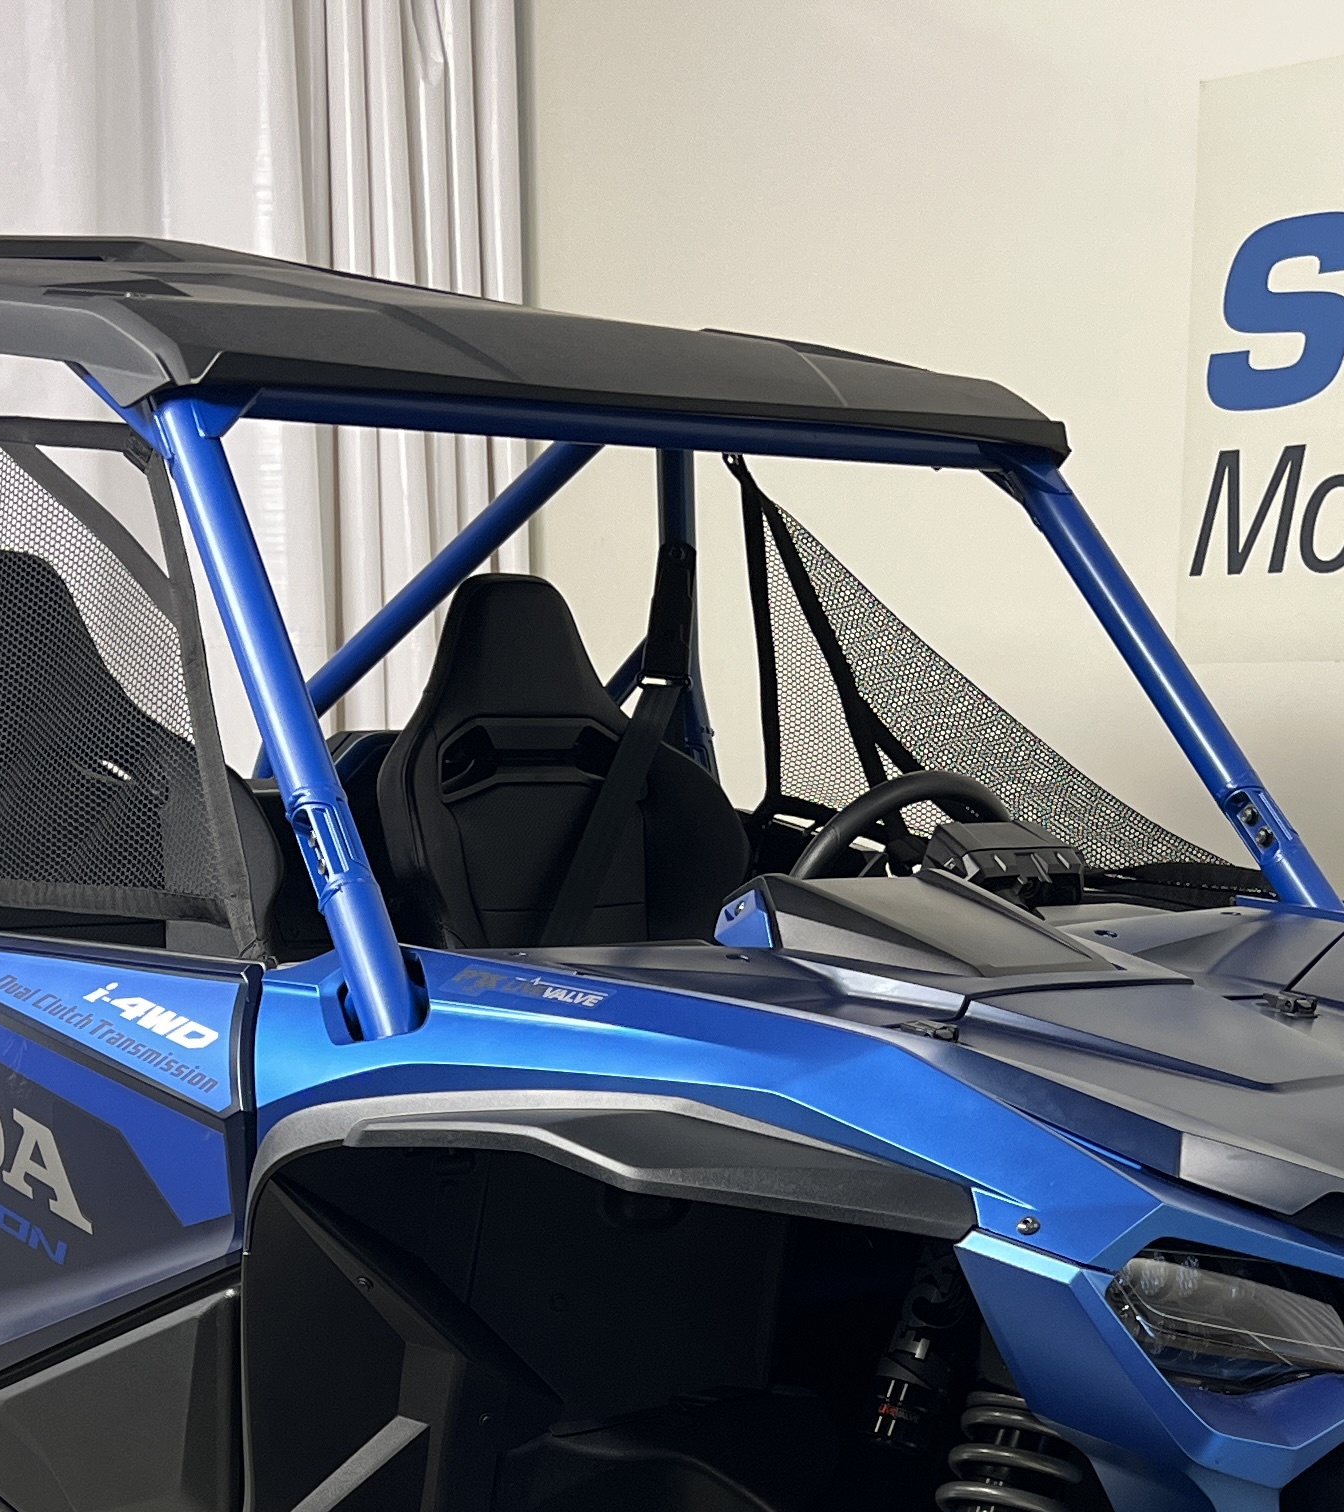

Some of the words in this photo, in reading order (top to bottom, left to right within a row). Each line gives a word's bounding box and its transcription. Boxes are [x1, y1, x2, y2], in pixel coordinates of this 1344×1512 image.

[83, 982, 219, 1049] i-4WD
[542, 986, 604, 1008] VALVE
[32, 992, 94, 1030] Clutch
[89, 1018, 219, 1094] Transmission
